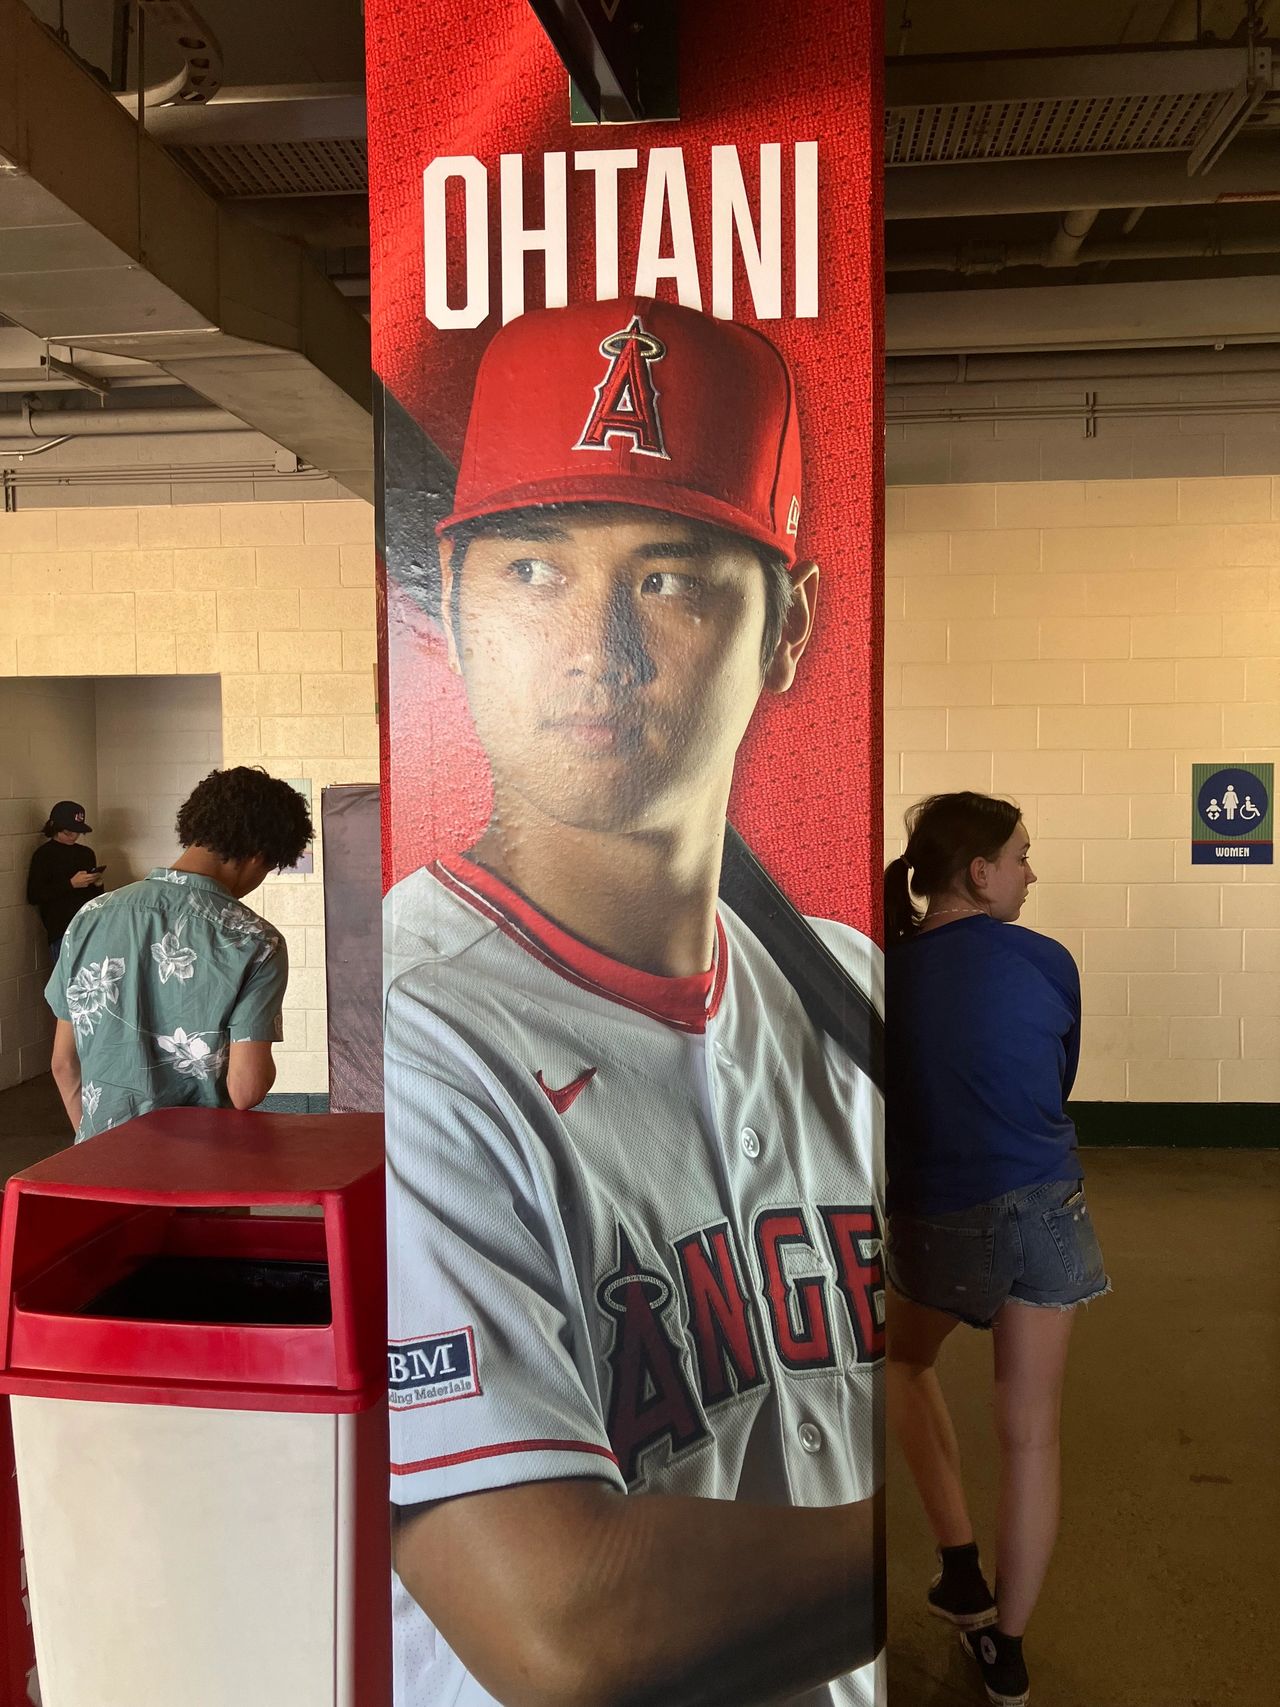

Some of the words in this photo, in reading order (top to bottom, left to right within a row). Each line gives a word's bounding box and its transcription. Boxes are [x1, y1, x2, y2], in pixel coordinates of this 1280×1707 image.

[422, 141, 819, 330] OHTANI
[571, 316, 672, 461] A
[1215, 847, 1250, 857] WOMEN
[413, 1381, 472, 1400] Materials
